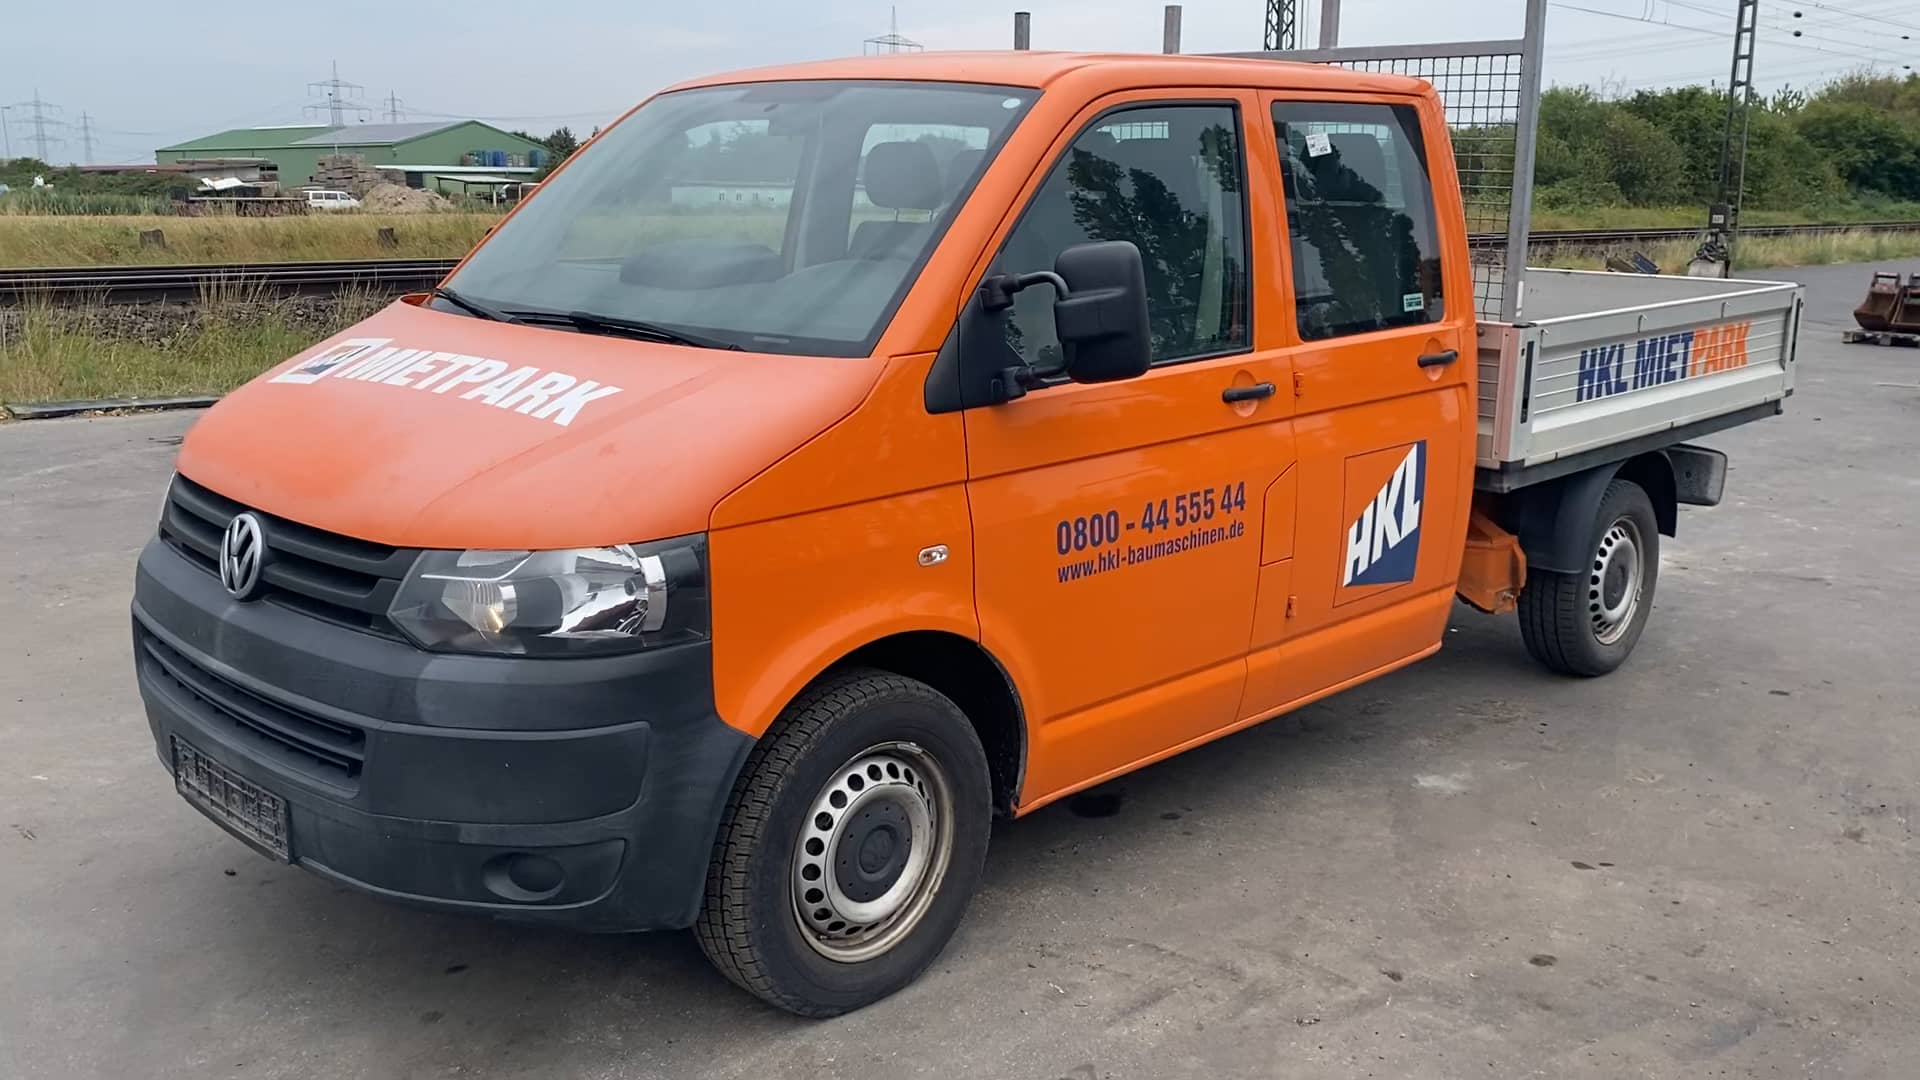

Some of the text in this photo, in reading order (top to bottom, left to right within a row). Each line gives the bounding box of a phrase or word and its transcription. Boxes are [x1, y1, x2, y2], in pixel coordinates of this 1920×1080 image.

[334, 347, 624, 426] MIETPARK
[1576, 320, 1752, 402] HKL MIETPARK
[1057, 510, 1120, 555] 0800
[1141, 499, 1169, 534] 44
[1175, 488, 1215, 527] 555
[1221, 481, 1246, 514] 44
[1057, 520, 1244, 583] www.hkl-baumaschinen.de
[1343, 443, 1420, 587] HKL
